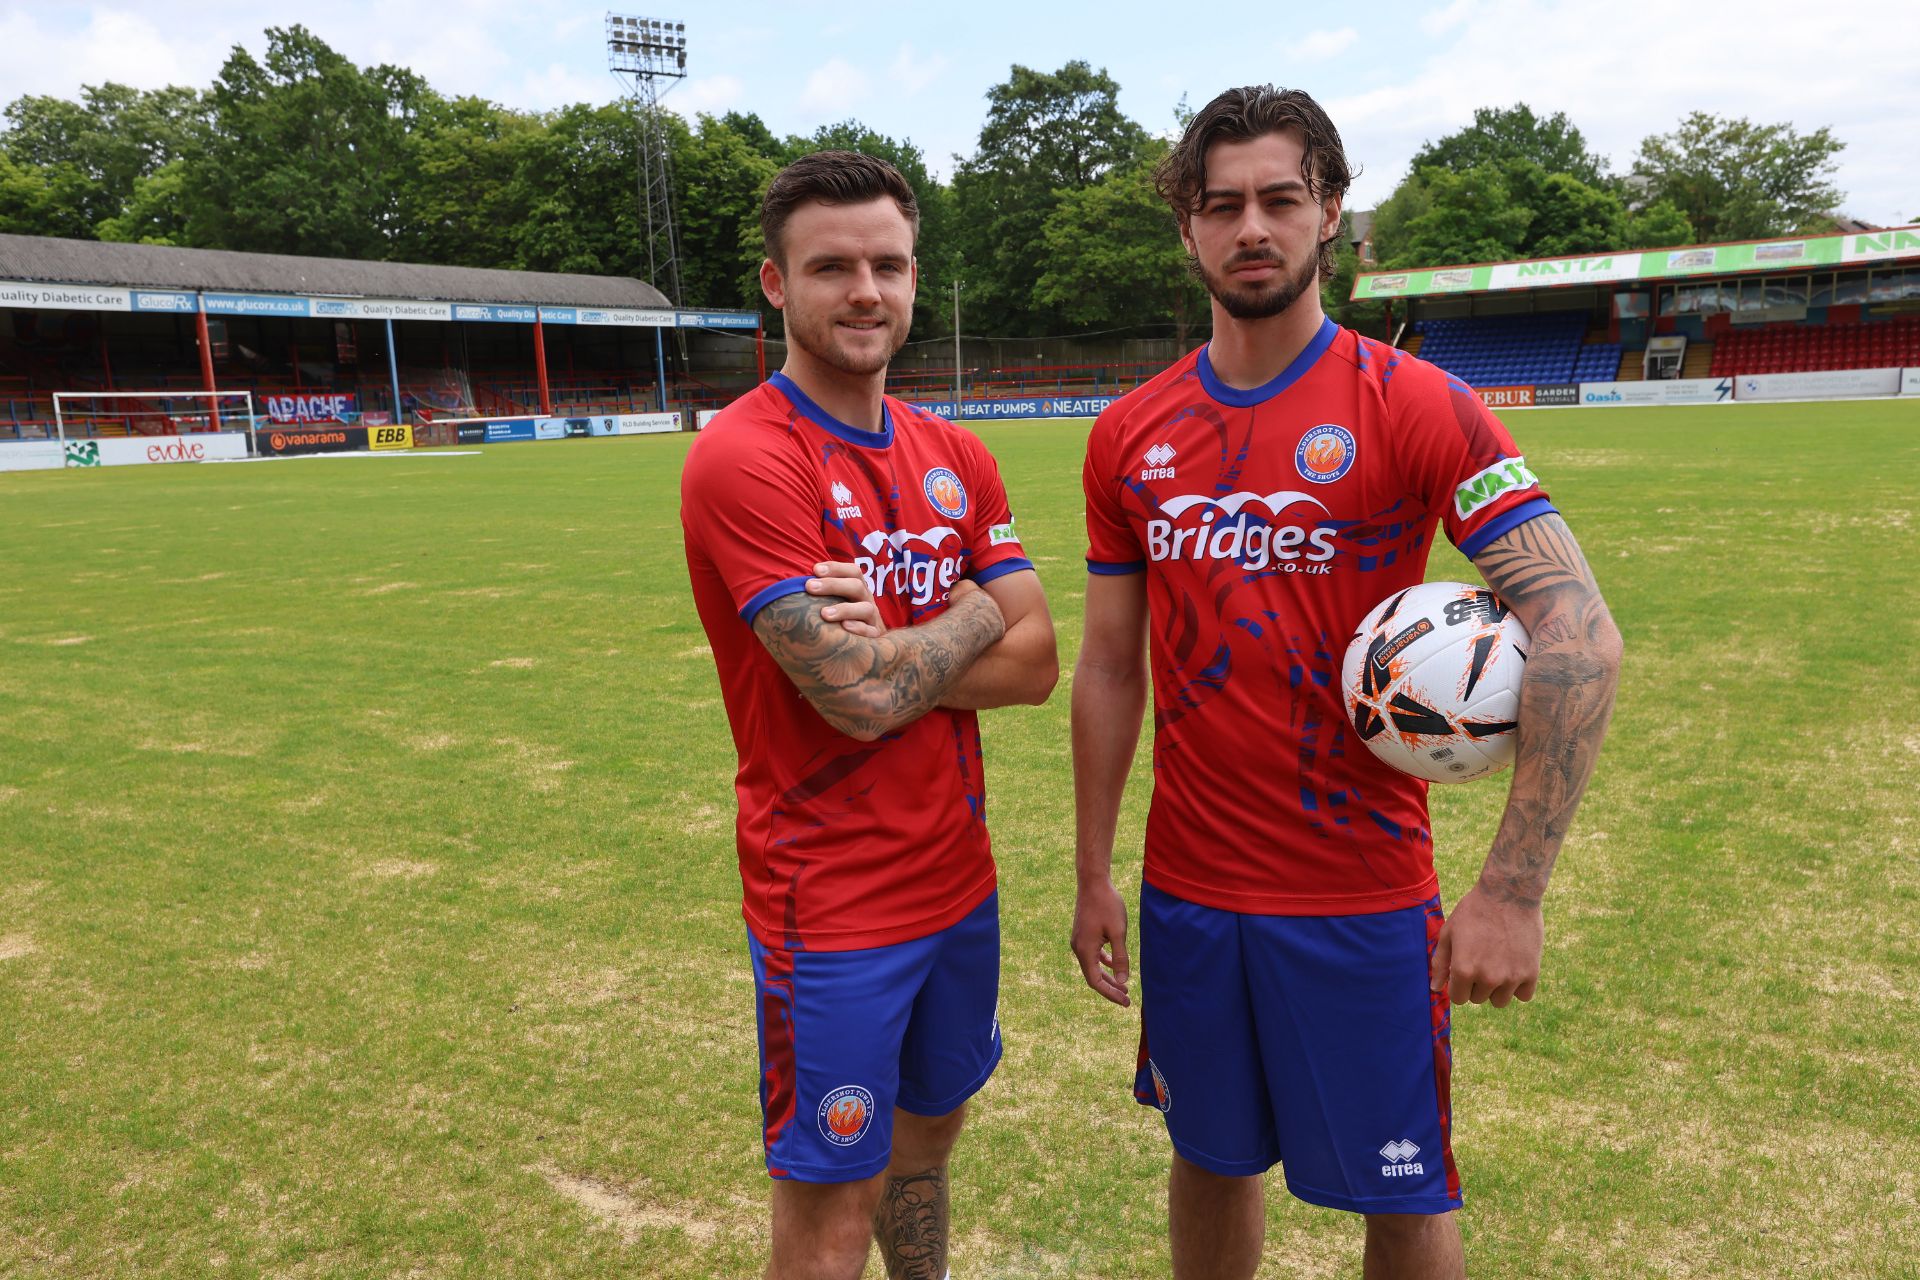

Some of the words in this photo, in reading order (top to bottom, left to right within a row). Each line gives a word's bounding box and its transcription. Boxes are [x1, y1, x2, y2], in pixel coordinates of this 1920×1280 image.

[1517, 257, 1613, 277] NATTA
[1, 291, 38, 304] uality
[42, 292, 93, 304] Diabetic
[96, 294, 123, 305] Care
[207, 299, 304, 312] www.glucorx.co.uk
[363, 304, 393, 316] Quality
[395, 305, 427, 316] Diabetic
[429, 306, 447, 316] Care
[497, 309, 523, 320] Quality
[558, 311, 572, 320] Care
[613, 313, 634, 323] Quality
[636, 314, 658, 323] Diabetic
[660, 315, 672, 323] Care
[1535, 388, 1576, 397] GARDEN
[1585, 390, 1622, 402] Oasis
[267, 396, 347, 422] APACHE
[960, 404, 989, 416] HEAT
[993, 402, 1037, 415] PUMPS
[633, 420, 652, 428] Building
[285, 432, 346, 446] vanarama
[376, 428, 406, 444] EBB
[1298, 427, 1334, 456] ALDERSHOT
[1334, 428, 1352, 444] TOWN
[147, 438, 205, 461] evolve
[1141, 466, 1176, 481] errea
[1304, 468, 1317, 479] THE
[1317, 470, 1340, 480] SHOTS
[836, 505, 862, 519] errea
[1147, 512, 1338, 571] Bridges
[1271, 561, 1334, 575] .co.uk
[1379, 630, 1421, 665] vanarama
[820, 1089, 855, 1117] ALDERSHOT
[855, 1090, 871, 1105] TOWN
[827, 1130, 841, 1142] THE
[1381, 1162, 1424, 1177] errea
